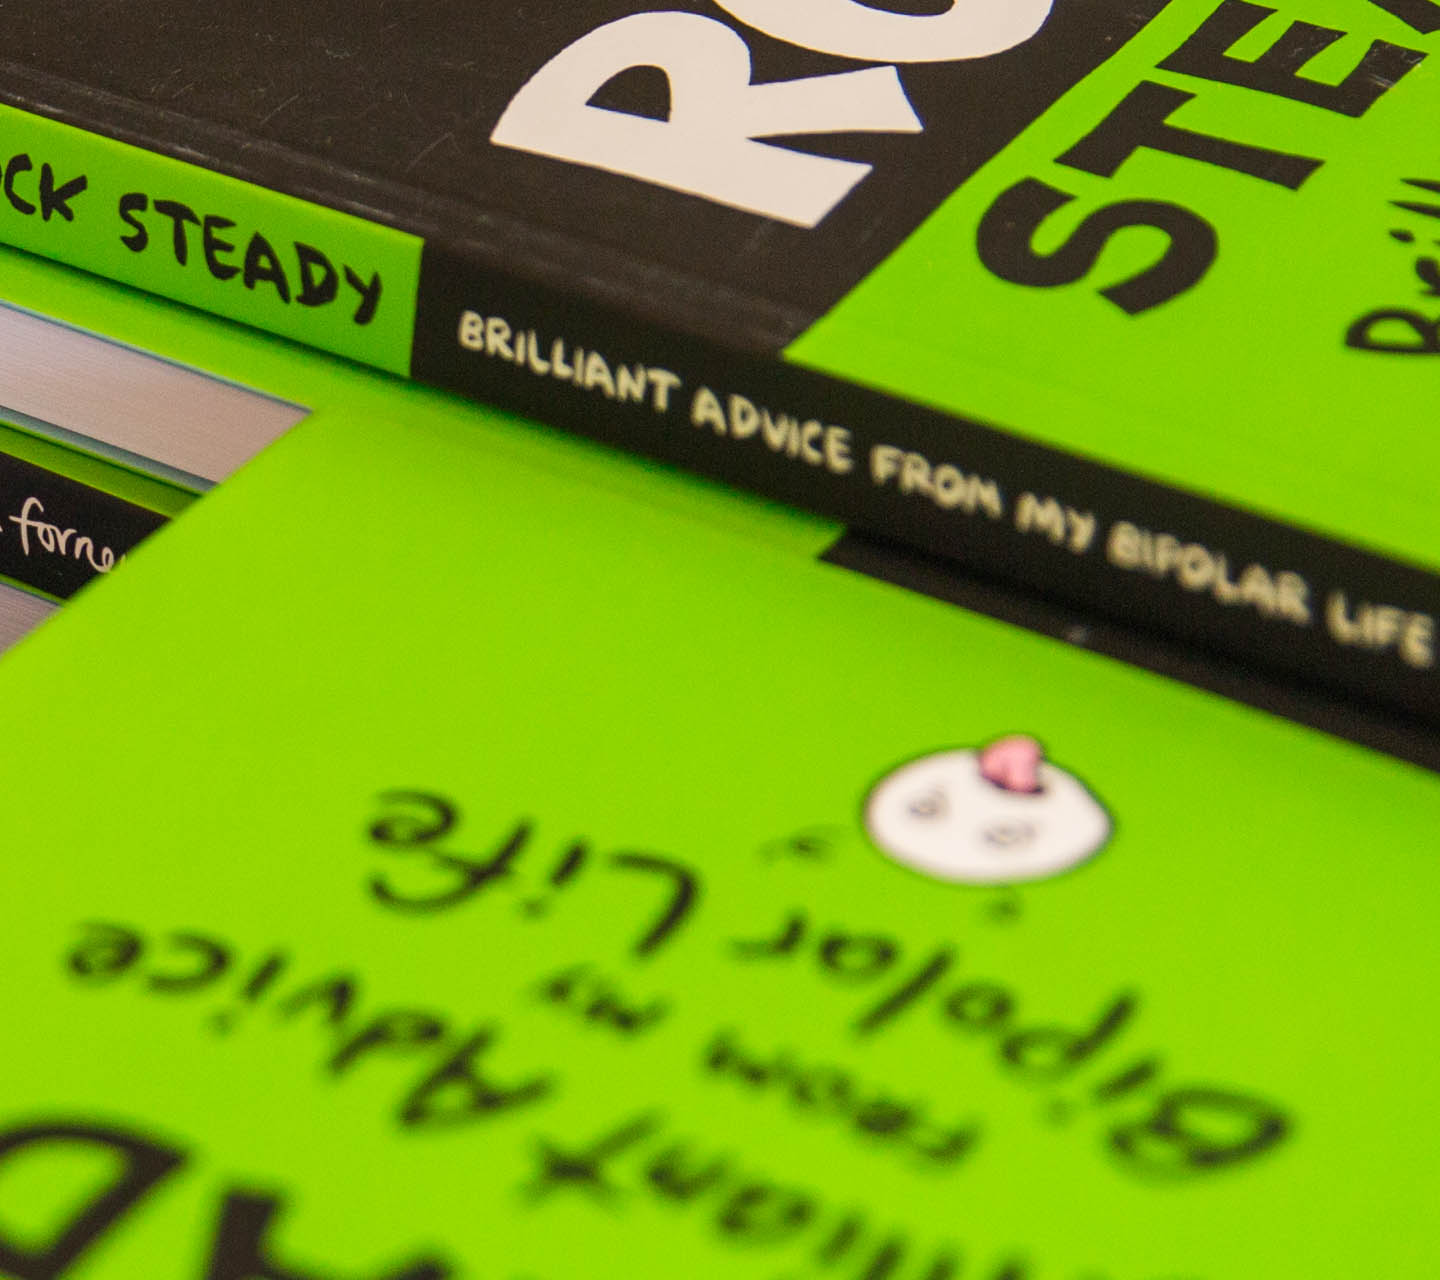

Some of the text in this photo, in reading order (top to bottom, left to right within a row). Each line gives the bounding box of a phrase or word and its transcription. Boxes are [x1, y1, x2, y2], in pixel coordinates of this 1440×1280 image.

[9, 496, 129, 575] forne
[117, 192, 384, 326] STEADY
[457, 309, 681, 413] BRILLIANT
[692, 385, 855, 476] ADVICE
[870, 443, 1001, 519] FROM
[1016, 494, 1098, 556] MY
[1107, 520, 1312, 624] BIPOLAR
[1328, 588, 1438, 669] LIFE
[60, 915, 560, 1144] Advice
[363, 783, 1300, 1187] Bipolar Life
[701, 1020, 988, 1175] FROM
